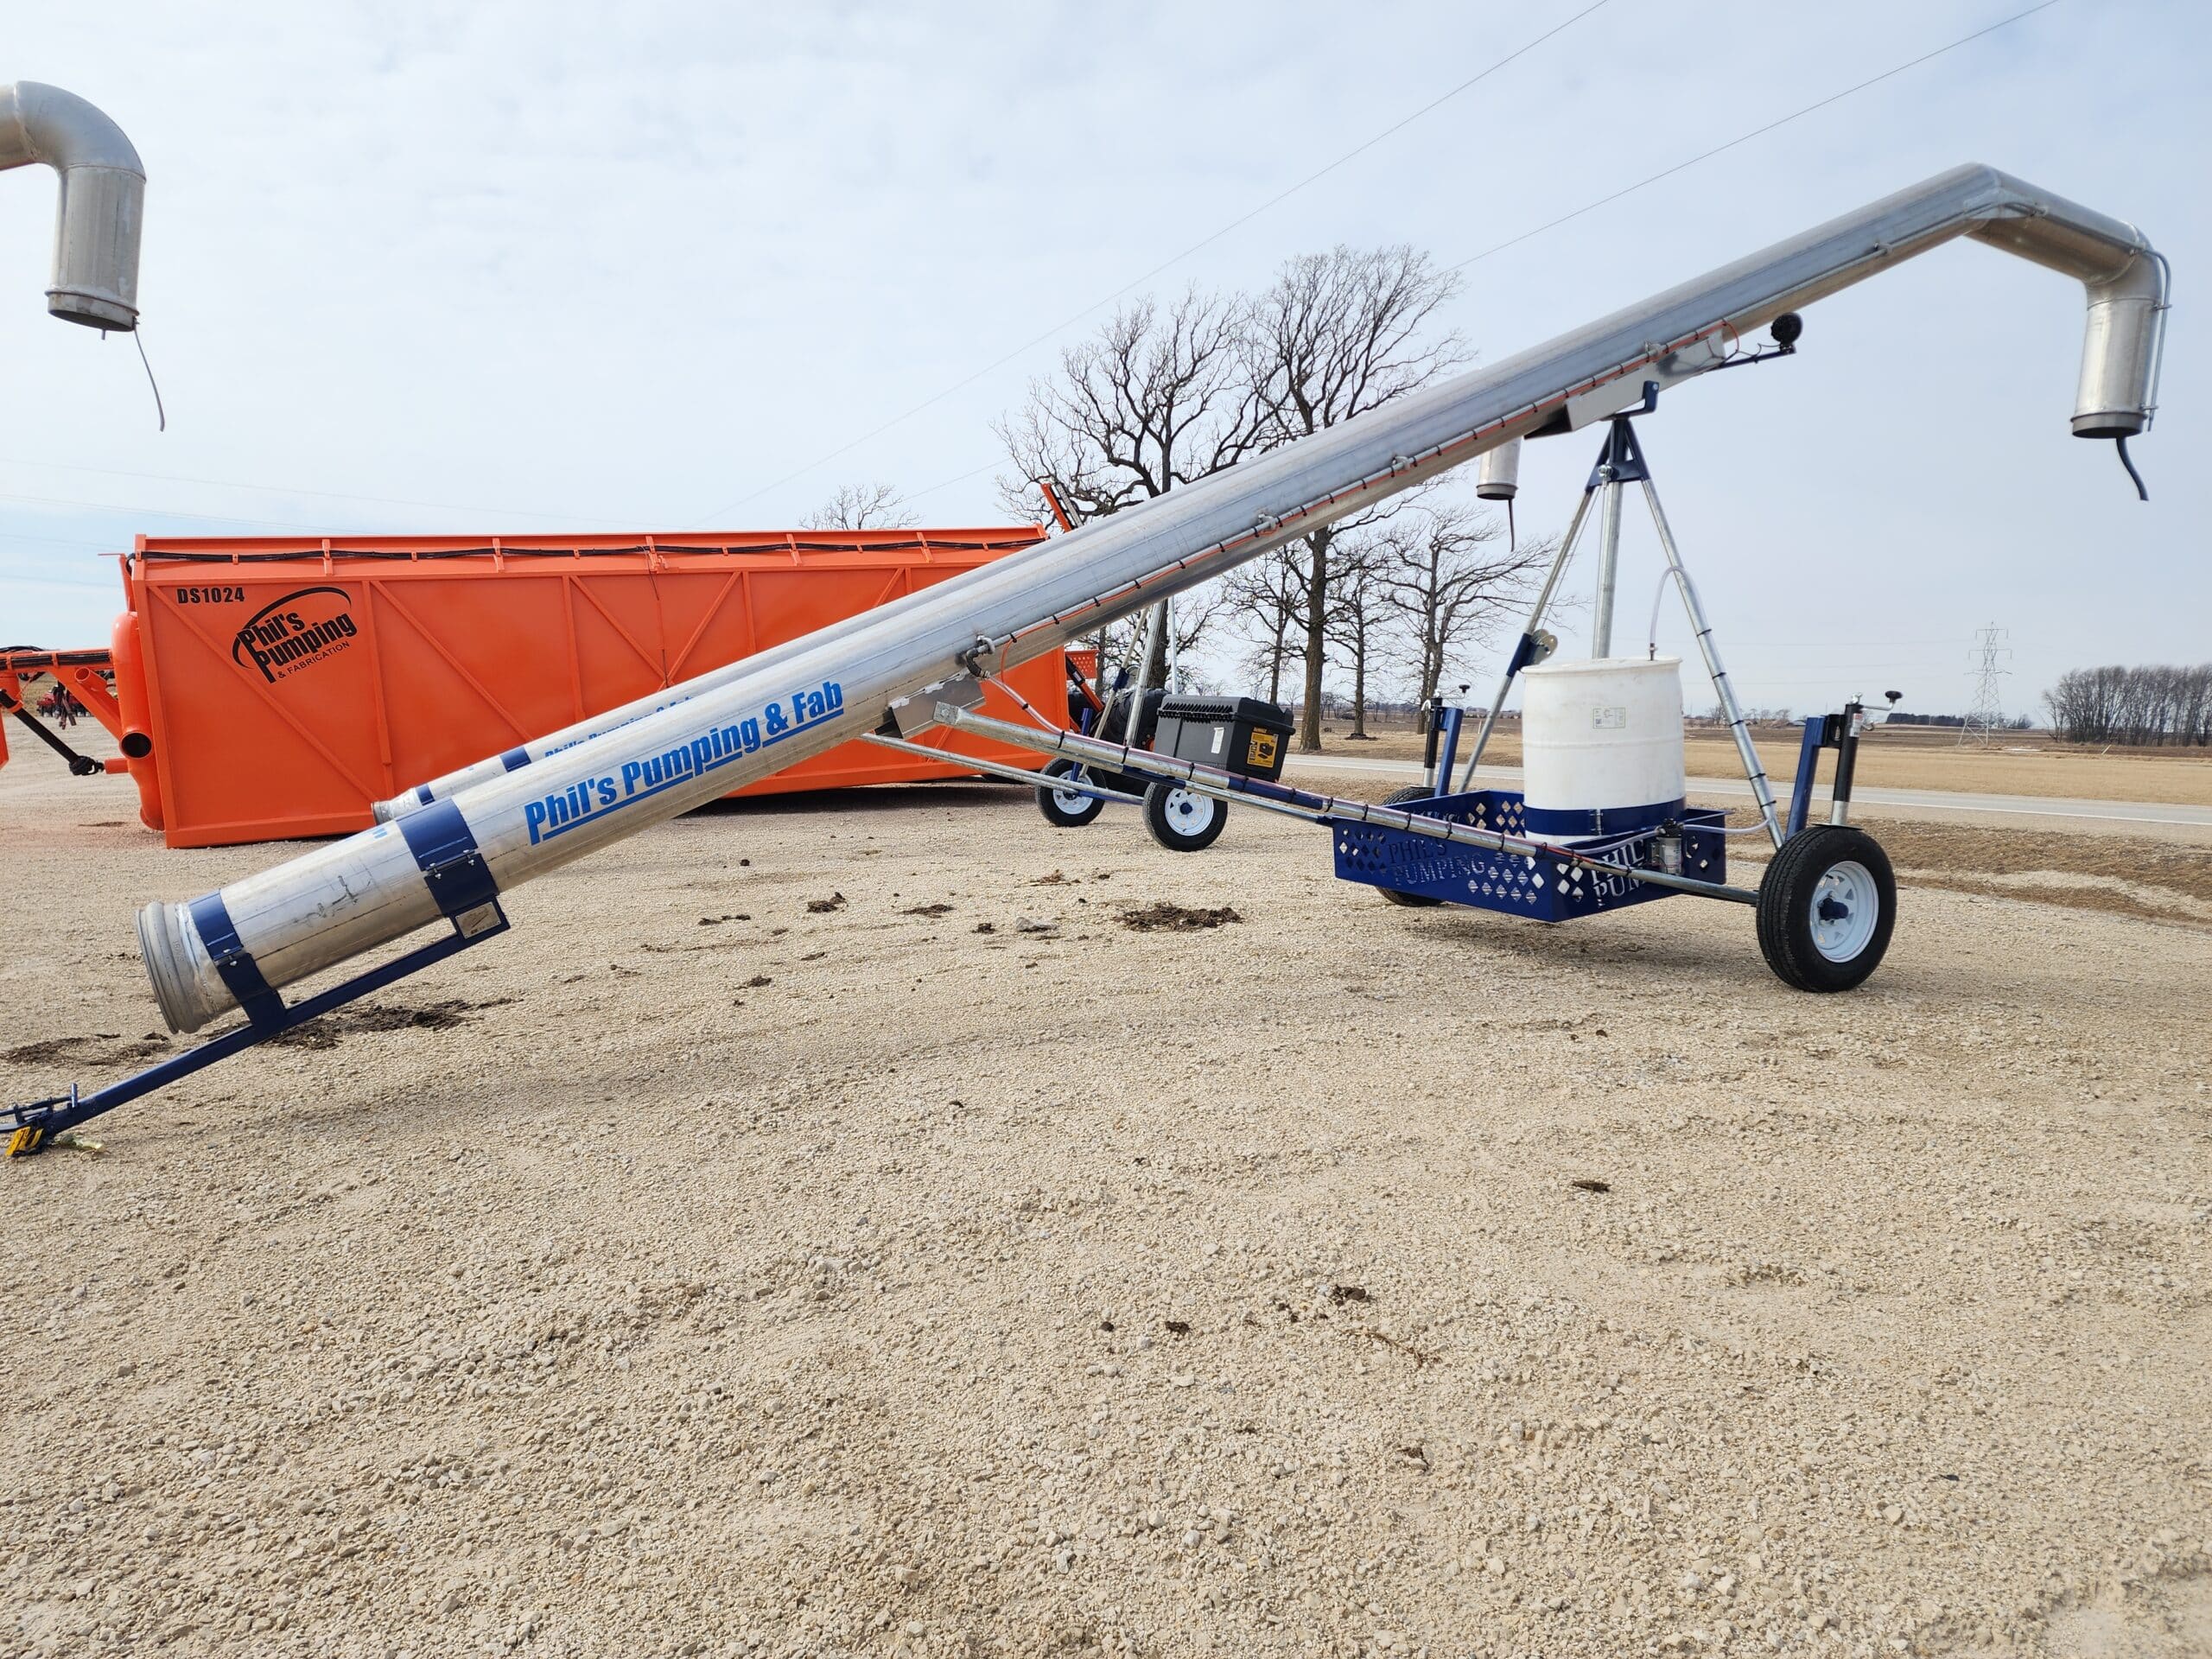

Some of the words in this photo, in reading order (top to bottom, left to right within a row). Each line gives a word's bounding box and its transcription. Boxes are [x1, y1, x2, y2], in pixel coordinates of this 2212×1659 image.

[176, 587, 245, 604] DS1024
[237, 612, 306, 650] Phil's
[256, 613, 358, 683] Pumping
[276, 671, 287, 679] &
[287, 640, 350, 675] FABRICATION
[524, 778, 617, 845] Phil's
[621, 717, 761, 796] Pumping
[764, 702, 790, 735] &
[791, 681, 843, 724] Fab
